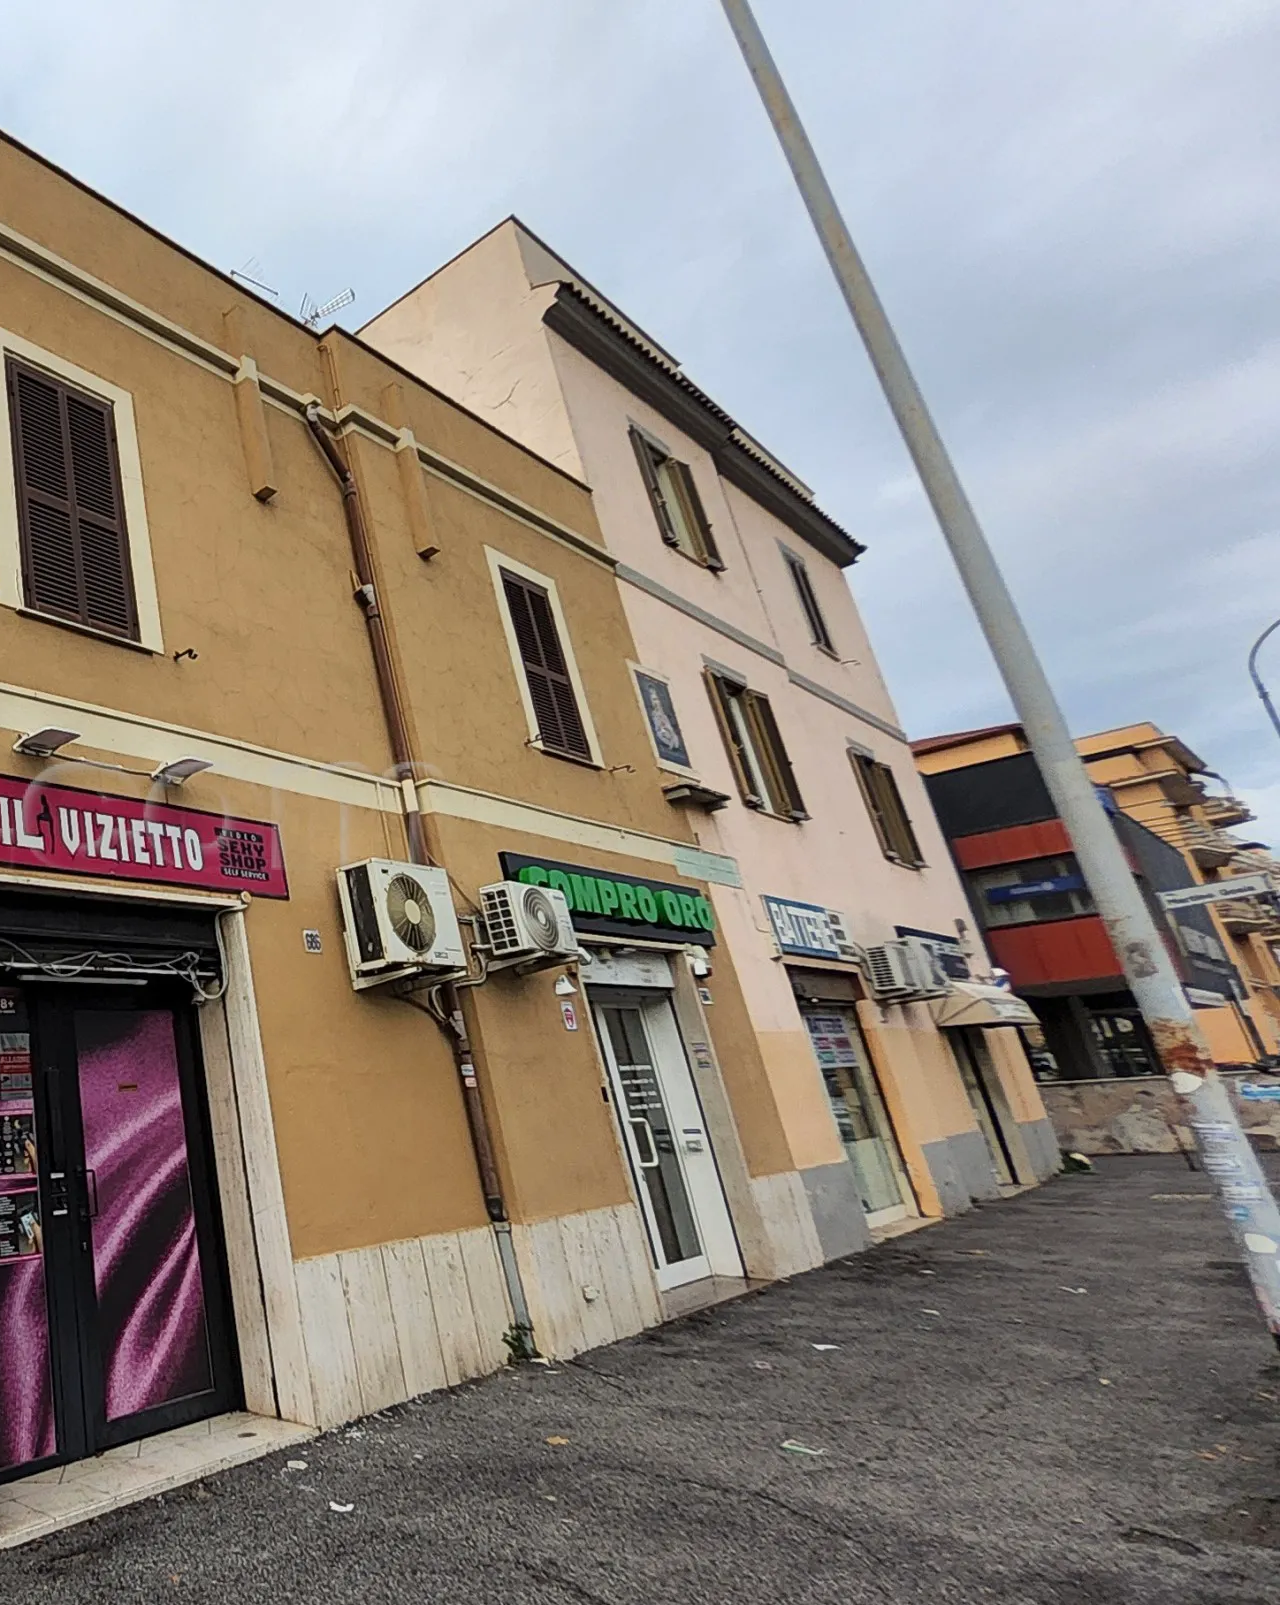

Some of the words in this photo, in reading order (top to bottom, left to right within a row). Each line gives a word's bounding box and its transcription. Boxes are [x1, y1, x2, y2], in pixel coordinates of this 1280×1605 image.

[57, 806, 204, 871] VIZIETTO
[217, 838, 264, 857] SEXY
[220, 852, 266, 870] SHOP
[660, 890, 716, 931] ORO
